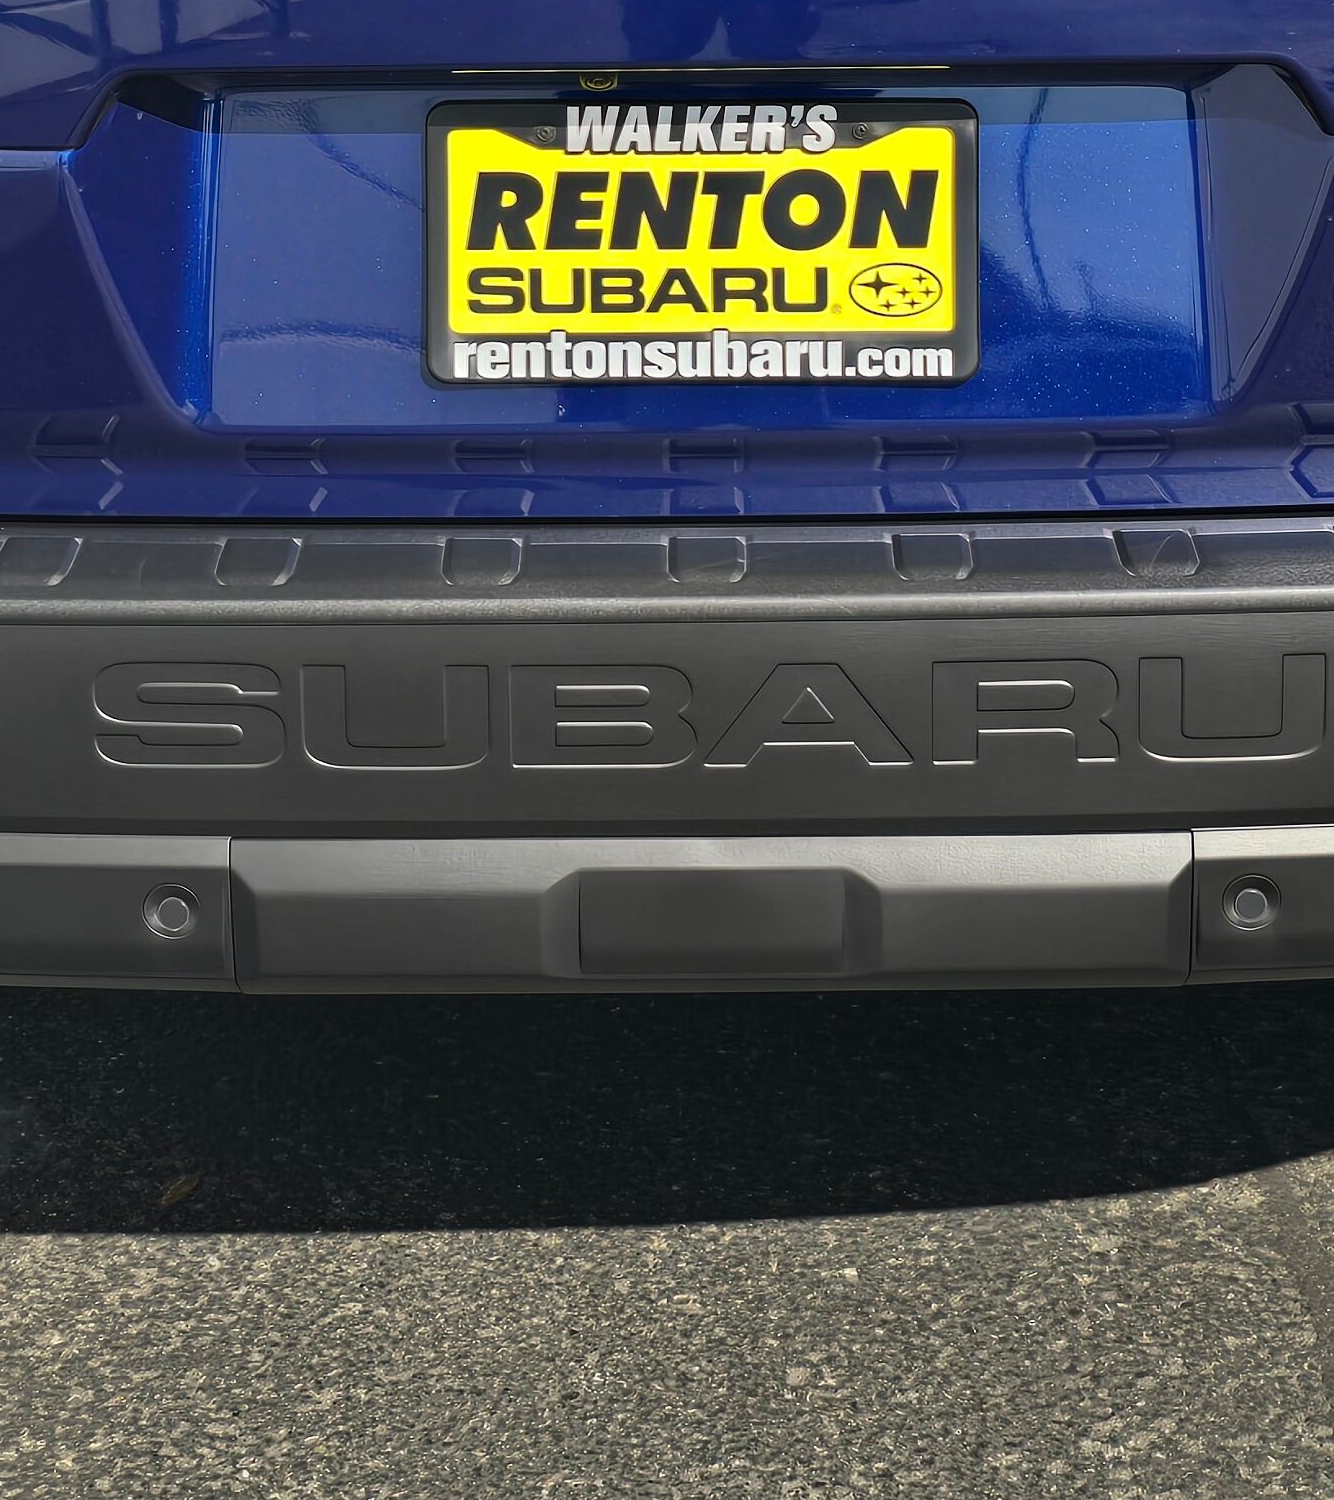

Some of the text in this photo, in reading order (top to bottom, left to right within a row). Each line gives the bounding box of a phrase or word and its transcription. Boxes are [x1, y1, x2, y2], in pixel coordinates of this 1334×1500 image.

[567, 103, 839, 155] WALKER'S
[467, 168, 939, 252] RENTON
[467, 267, 831, 314] SUBARU
[453, 329, 953, 379] rentonsubaru.com
[93, 653, 1326, 770] SUBARU
